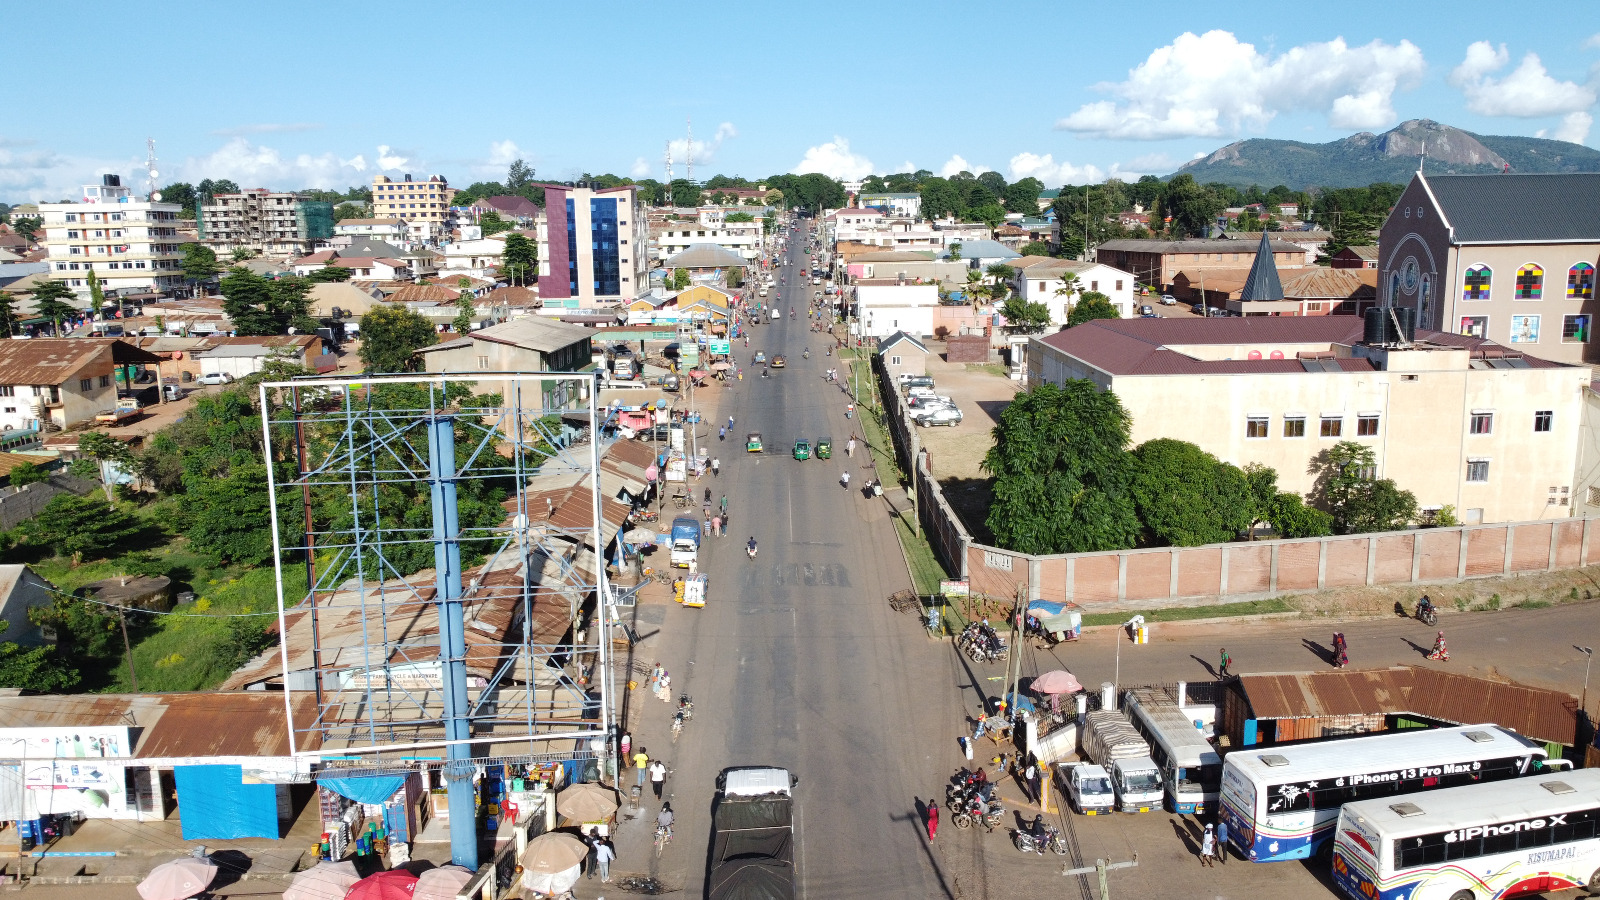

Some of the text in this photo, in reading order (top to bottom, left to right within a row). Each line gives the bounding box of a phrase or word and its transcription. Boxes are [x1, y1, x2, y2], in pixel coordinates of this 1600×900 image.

[1349, 764, 1471, 786] iPhone 13 Pro Max
[1459, 814, 1568, 842] iPhone X
[1527, 846, 1577, 865] KISUMAPAI
